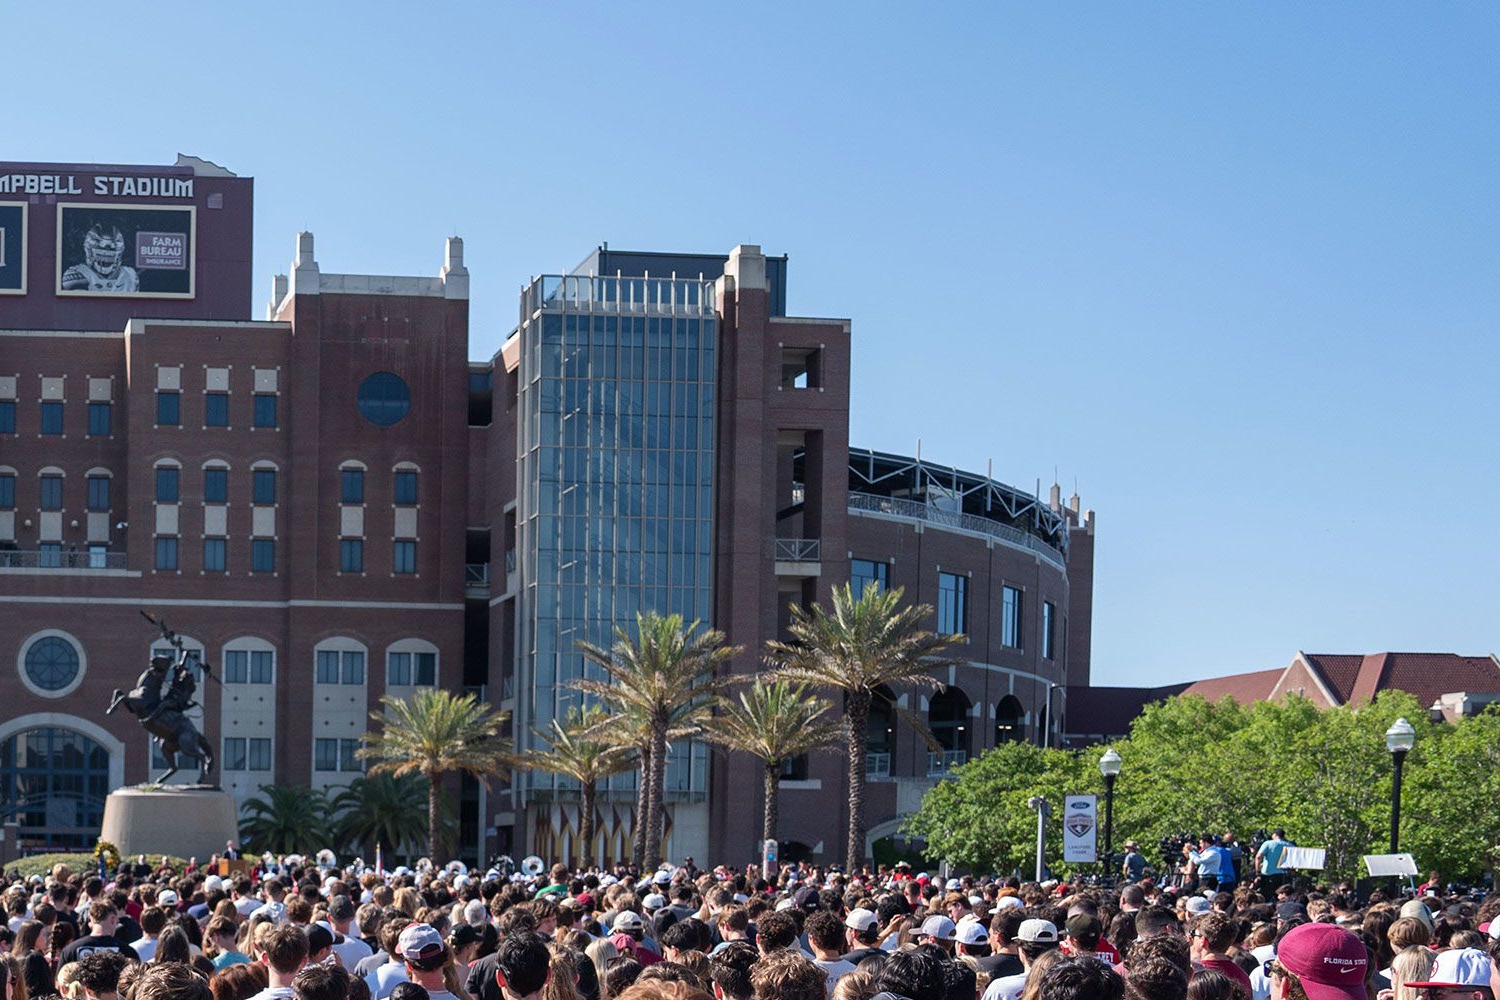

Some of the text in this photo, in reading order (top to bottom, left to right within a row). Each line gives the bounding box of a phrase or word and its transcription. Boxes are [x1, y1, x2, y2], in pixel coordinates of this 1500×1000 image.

[93, 175, 194, 198] STADIUM
[152, 236, 182, 247] FARM
[140, 246, 182, 256] BUREAU
[1323, 957, 1353, 965] FLORIDA
